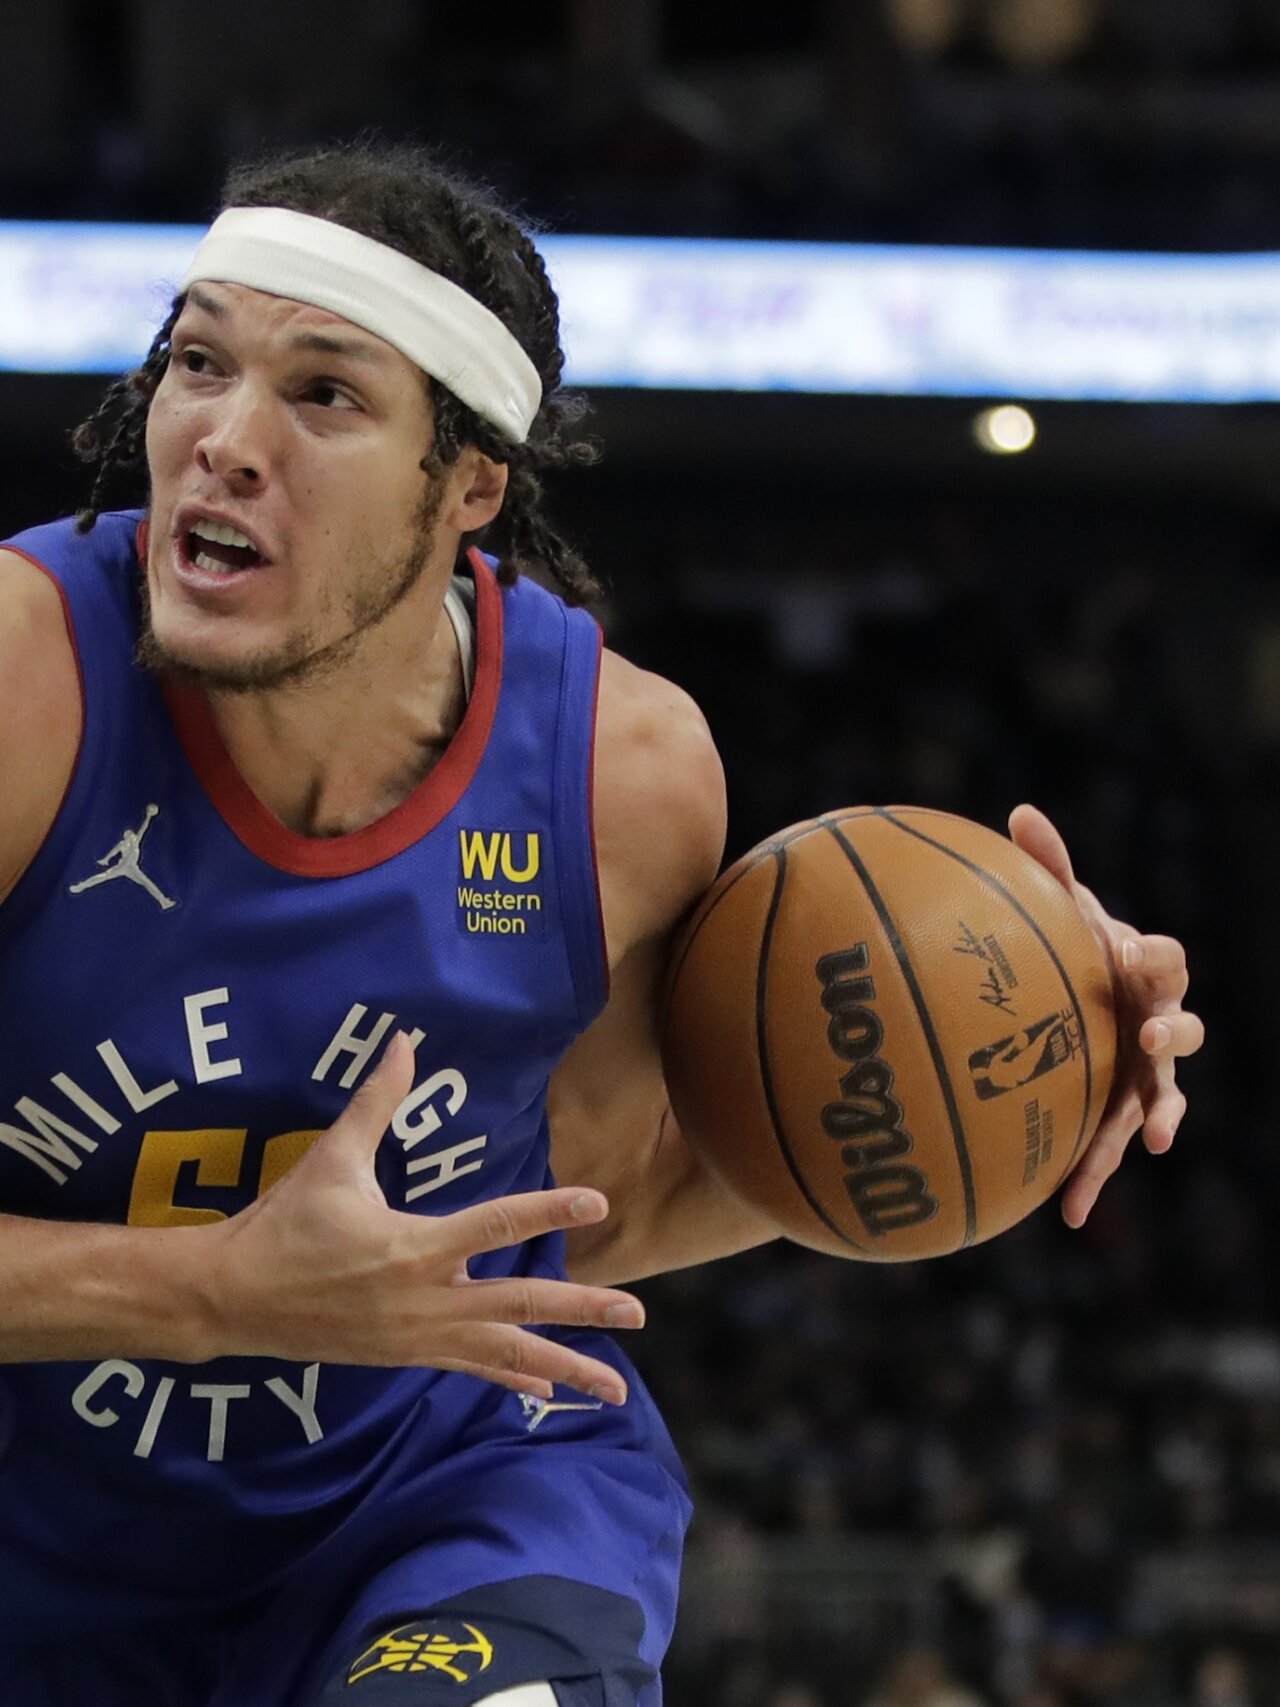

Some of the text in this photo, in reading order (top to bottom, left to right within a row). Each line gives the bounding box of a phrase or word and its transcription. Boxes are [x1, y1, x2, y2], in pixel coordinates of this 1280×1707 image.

[459, 829, 540, 883] WU
[457, 887, 541, 911] Western
[466, 910, 526, 934] Union
[1049, 1029, 1067, 1065] NBA
[815, 941, 940, 1239] Wilson
[71, 1358, 324, 1462] CITY
